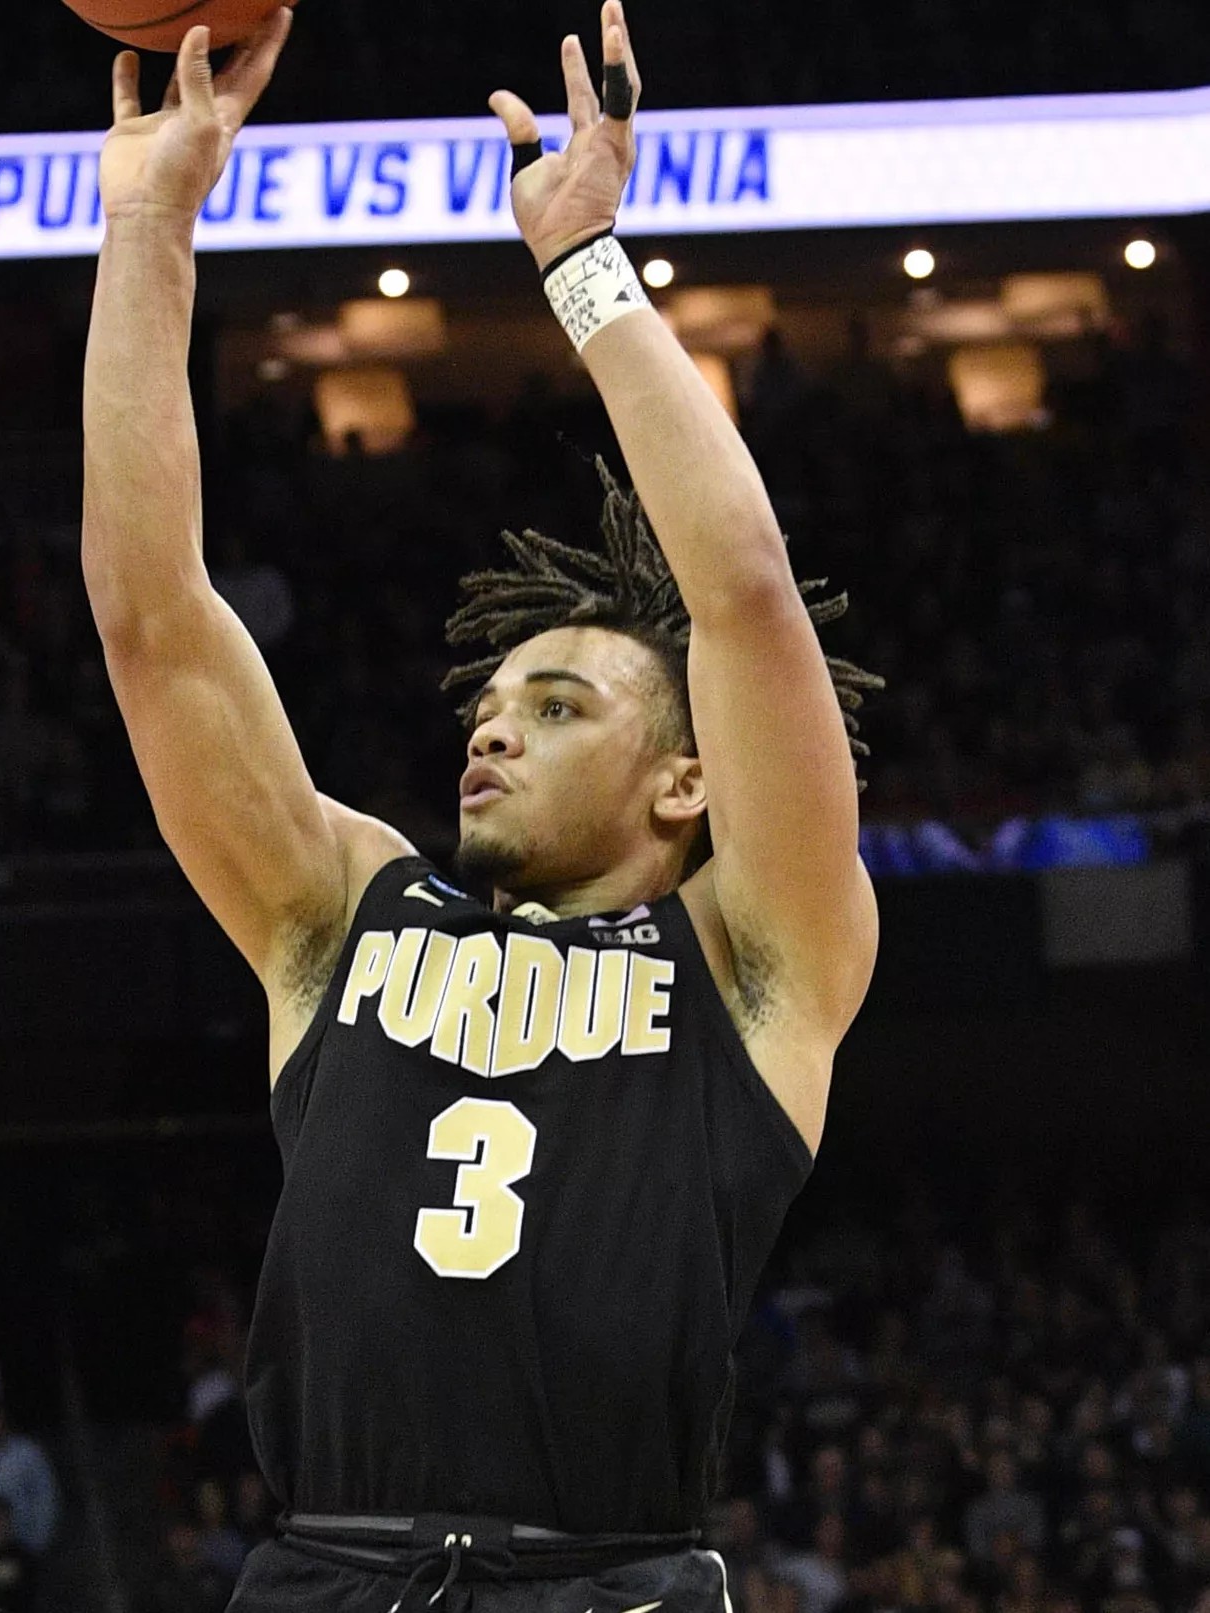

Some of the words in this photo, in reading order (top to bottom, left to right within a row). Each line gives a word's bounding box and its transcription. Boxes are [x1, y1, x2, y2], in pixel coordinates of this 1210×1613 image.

[322, 142, 411, 219] VS
[447, 129, 770, 214] VIINIA
[337, 928, 675, 1078] PURDUE
[414, 1097, 537, 1279] 3
